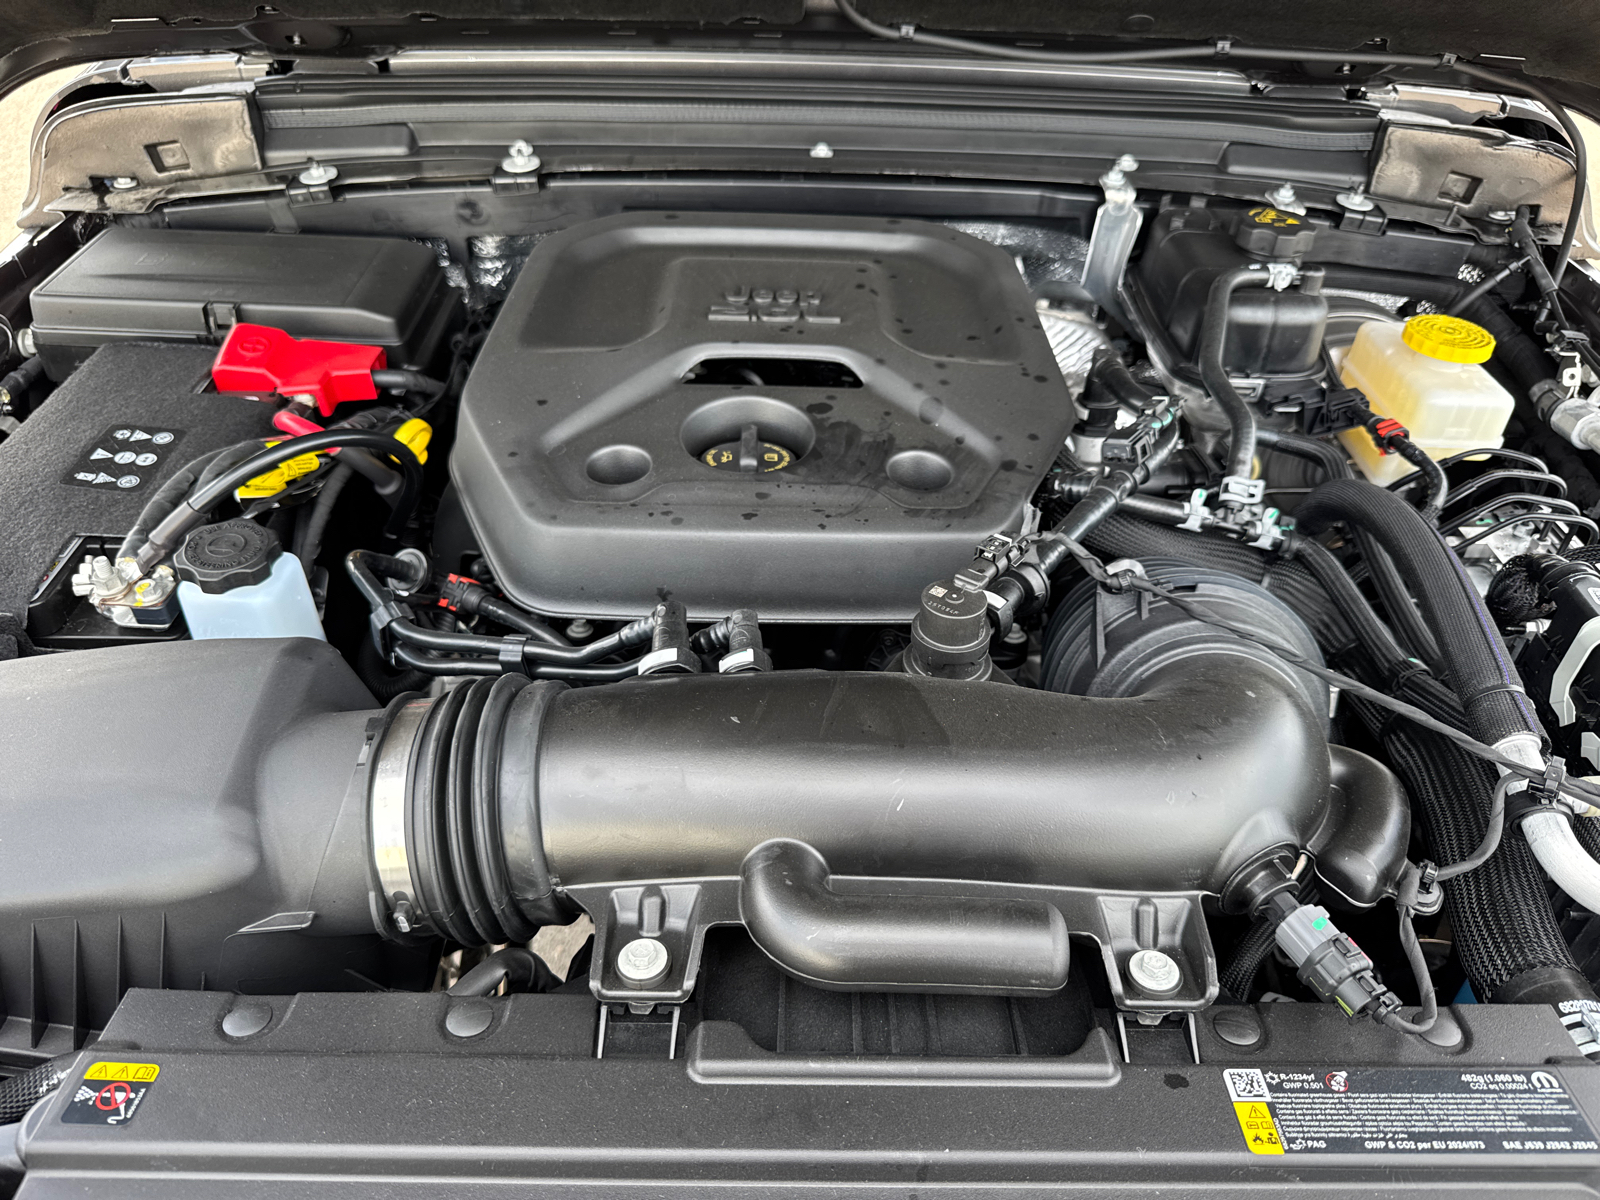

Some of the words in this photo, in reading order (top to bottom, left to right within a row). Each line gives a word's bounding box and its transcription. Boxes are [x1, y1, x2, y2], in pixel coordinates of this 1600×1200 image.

[724, 284, 822, 307] Jeep
[708, 305, 842, 325] 2.0L
[1306, 1140, 1327, 1149] PAG
[1364, 1140, 1386, 1149] GWP
[1387, 1140, 1396, 1149] &
[1396, 1140, 1416, 1149] CO2
[1432, 1140, 1446, 1149] EU
